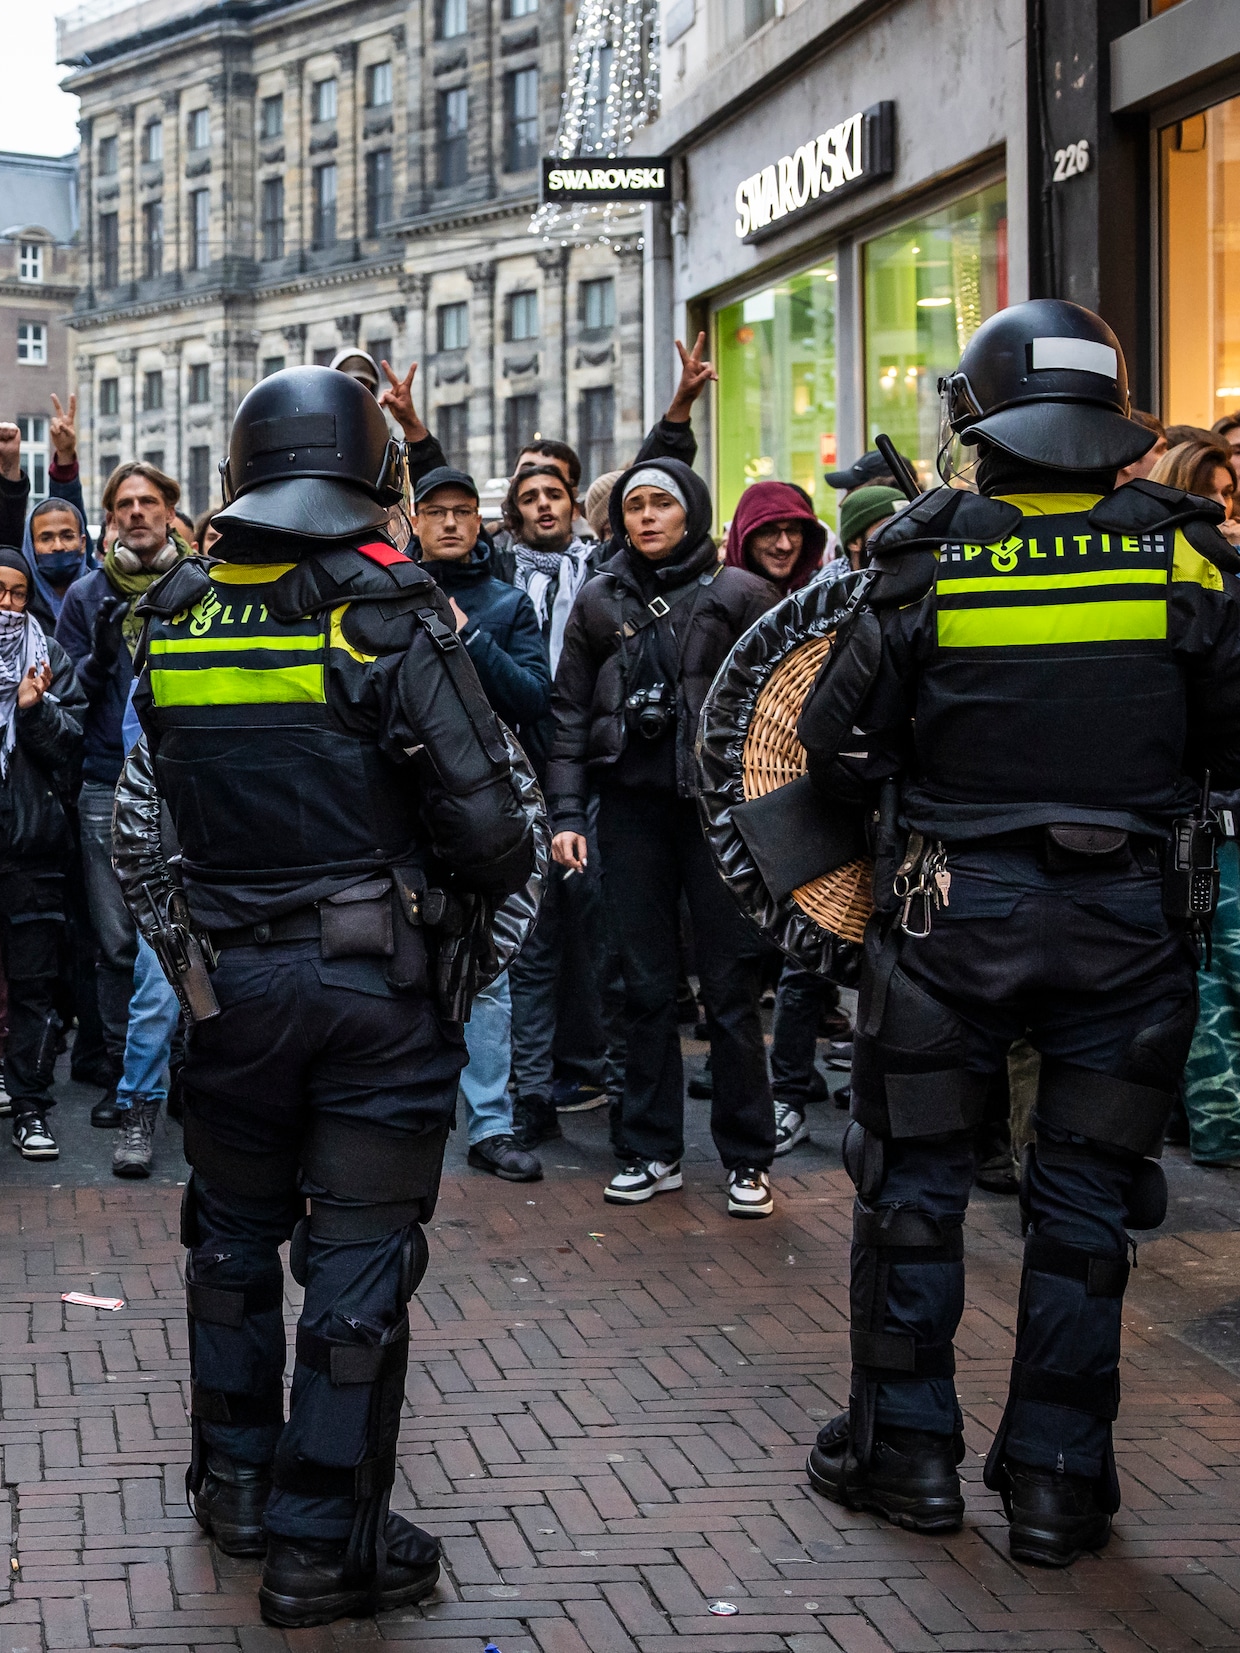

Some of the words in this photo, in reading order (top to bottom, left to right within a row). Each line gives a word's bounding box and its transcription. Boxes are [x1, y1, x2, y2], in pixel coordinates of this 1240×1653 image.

[547, 168, 665, 190] SWAROVSKI
[735, 112, 863, 238] SWAROVSKI
[1053, 139, 1089, 182] 226
[963, 533, 1141, 572] POLITIE
